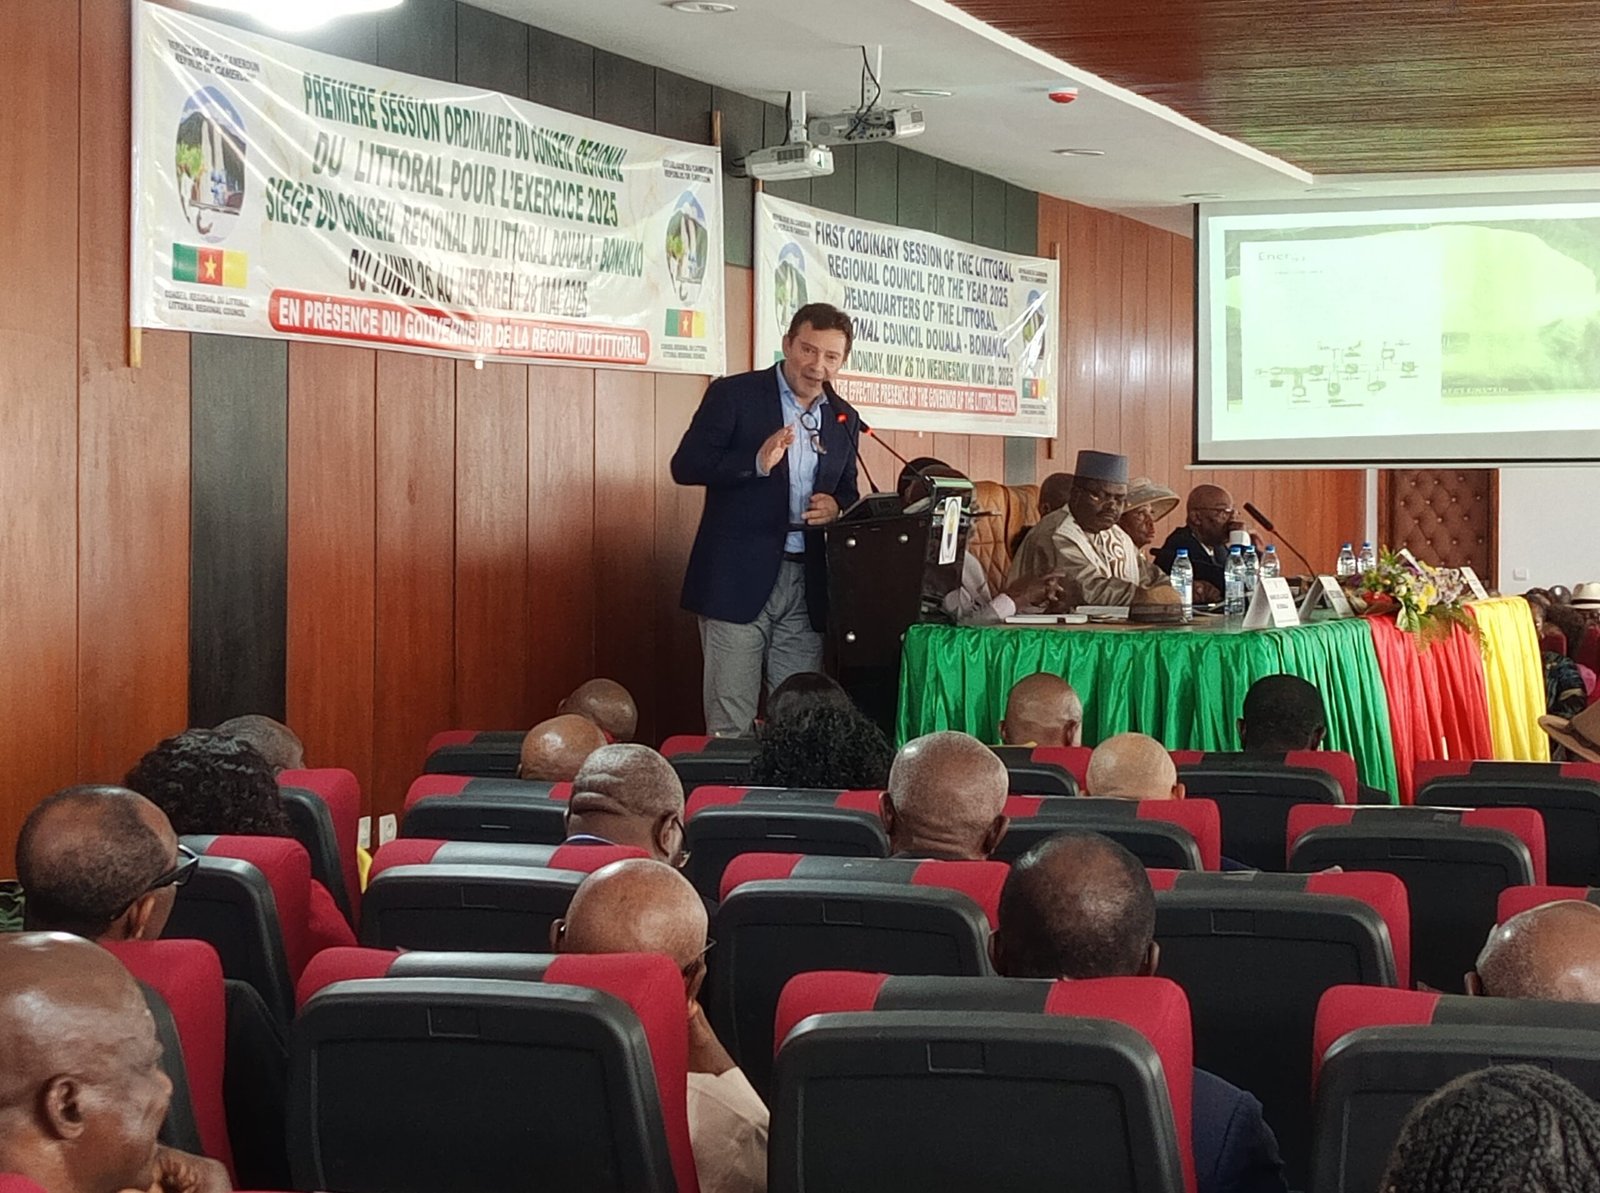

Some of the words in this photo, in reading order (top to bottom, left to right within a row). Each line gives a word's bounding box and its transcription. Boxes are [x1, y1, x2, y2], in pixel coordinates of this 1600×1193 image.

[303, 72, 378, 130] PREMIERE
[380, 90, 440, 143] SESSION
[444, 105, 513, 158] ORDINAIRE
[515, 121, 530, 161] DU
[531, 125, 575, 173] CONSEIL
[575, 138, 627, 183] REGIONAL
[312, 131, 346, 177] DU
[354, 139, 444, 197] LITTORAL
[450, 159, 496, 207] POUR
[501, 168, 584, 222] L'EXERCICE
[587, 186, 619, 227] 2025
[265, 177, 314, 227] SIEGE
[315, 187, 338, 232] DU
[338, 192, 395, 243] CONSEIL
[400, 203, 467, 253] REGIONAL
[471, 216, 490, 256] DU
[492, 219, 547, 265] LITTORAL
[548, 229, 593, 271] DOUALA
[599, 237, 644, 278] BONANJO
[815, 221, 845, 249] FIRST
[848, 228, 900, 260] ORDINARY
[902, 239, 942, 270] SESSION
[943, 249, 954, 271] OF
[956, 252, 974, 276] THE
[975, 256, 1014, 282] LITTORAL
[349, 248, 372, 292] DU
[371, 252, 416, 298] LUNDI
[416, 259, 434, 300] 26
[436, 261, 454, 303] AU
[456, 266, 519, 312] MERCREDI
[523, 273, 538, 314] 28
[540, 276, 562, 316] MAI
[562, 278, 589, 319] 2025
[827, 253, 880, 286] REGIONAL
[882, 264, 925, 293] COUNCIL
[927, 273, 945, 297] FOR
[947, 276, 964, 299] THE
[966, 280, 988, 304] YEAR
[989, 285, 1009, 308] 2025
[843, 285, 921, 320] HEADQUARTERS
[922, 299, 935, 322] OF
[937, 301, 954, 325] THE
[956, 305, 998, 332] LITTORAL
[278, 297, 300, 327] EN
[304, 297, 379, 335] PRÉSENCE
[381, 309, 401, 338] DU
[404, 313, 493, 348] GOUVERNEUR
[495, 324, 511, 349] DE
[513, 326, 529, 350] LA
[576, 332, 592, 355] DU
[883, 321, 924, 349] COUNCIL
[926, 328, 962, 353] DOUALA
[851, 349, 885, 376] MONDAY,
[886, 353, 904, 376] MAY
[905, 356, 914, 377] 26
[915, 357, 926, 378] TO
[971, 363, 986, 384] MAY
[998, 366, 1014, 386] 2025
